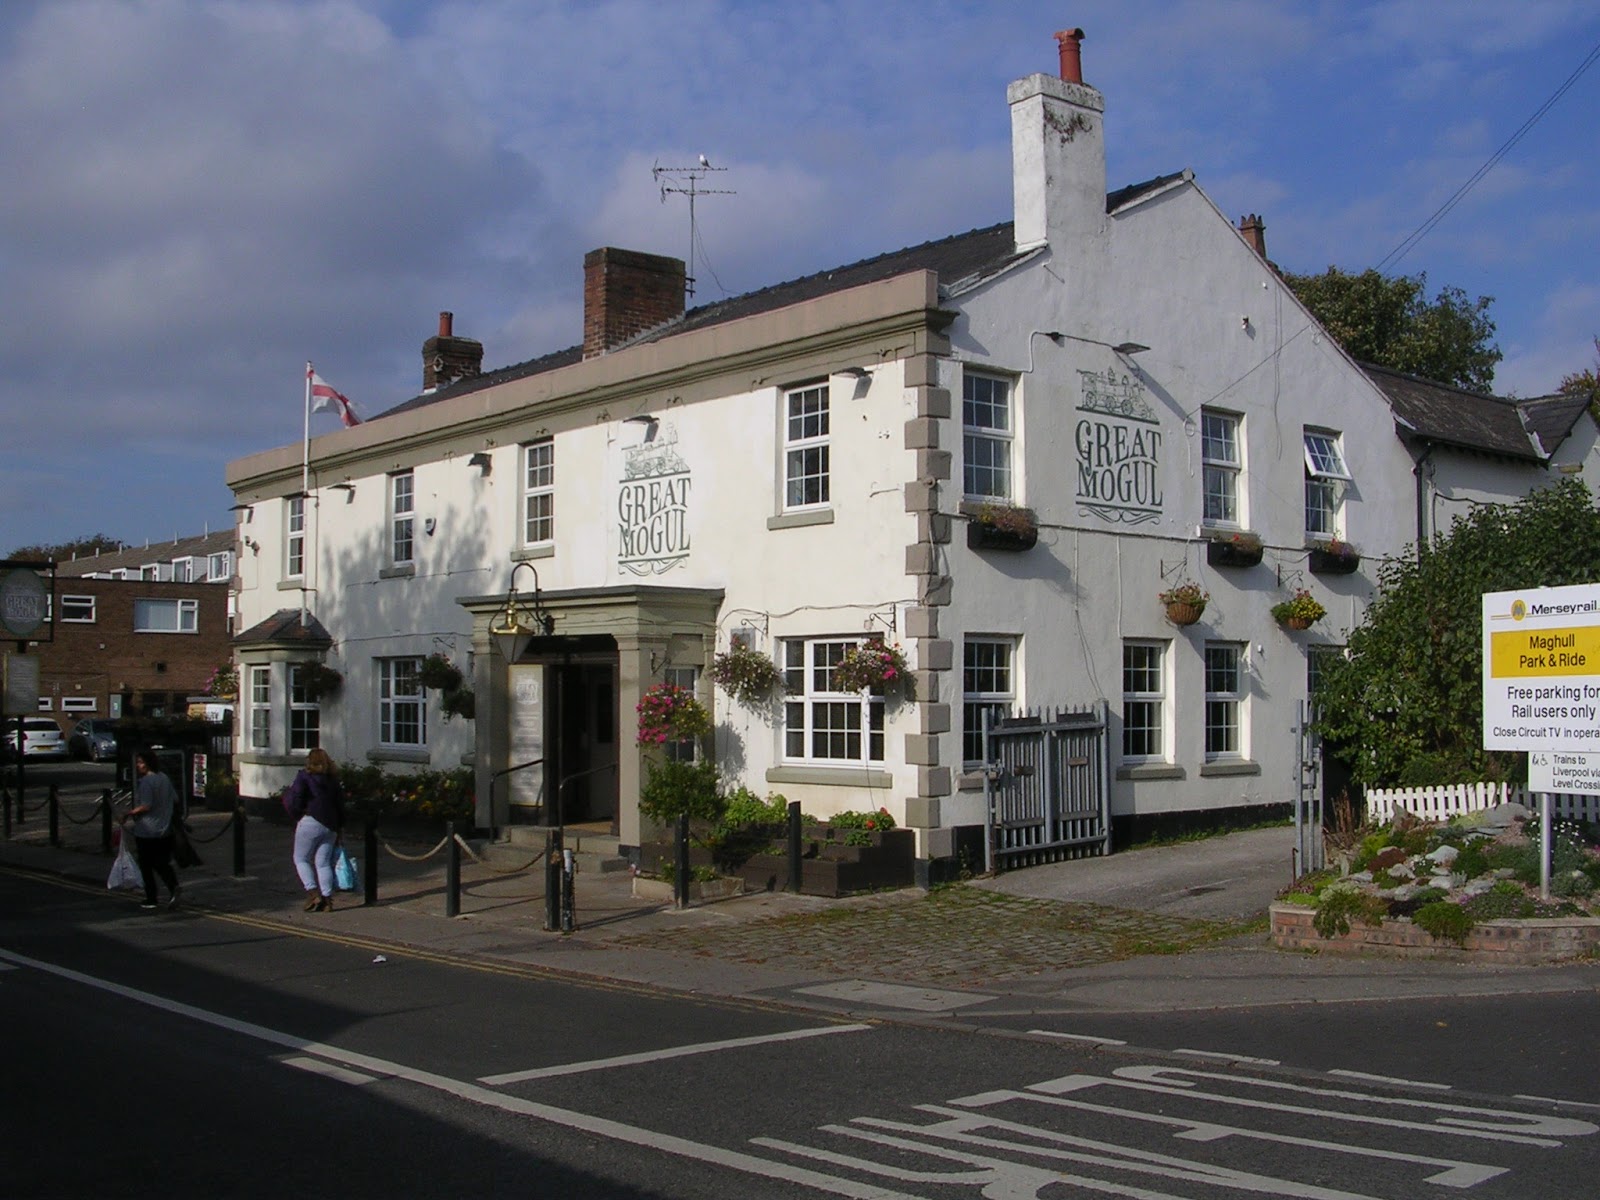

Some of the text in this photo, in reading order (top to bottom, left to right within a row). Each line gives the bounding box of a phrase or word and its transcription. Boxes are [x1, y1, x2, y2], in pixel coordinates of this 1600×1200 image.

[1075, 420, 1162, 476] GREAT
[1075, 458, 1163, 506] MOGUL
[618, 477, 691, 535] GREAT
[618, 508, 691, 558] MOGUL
[1531, 600, 1597, 615] Merseyrail
[1529, 633, 1575, 651] Maghull
[1519, 652, 1586, 668] Park & Ride
[1507, 684, 1600, 701] Free parking for
[1512, 704, 1596, 721] Rail users only
[1493, 727, 1517, 737] Close
[1518, 727, 1547, 737] Circuit
[1549, 727, 1561, 737] TV
[1564, 727, 1572, 737] in
[1553, 754, 1586, 765] Trains to
[1553, 767, 1590, 778] Liverpool
[1553, 779, 1574, 789] Level
